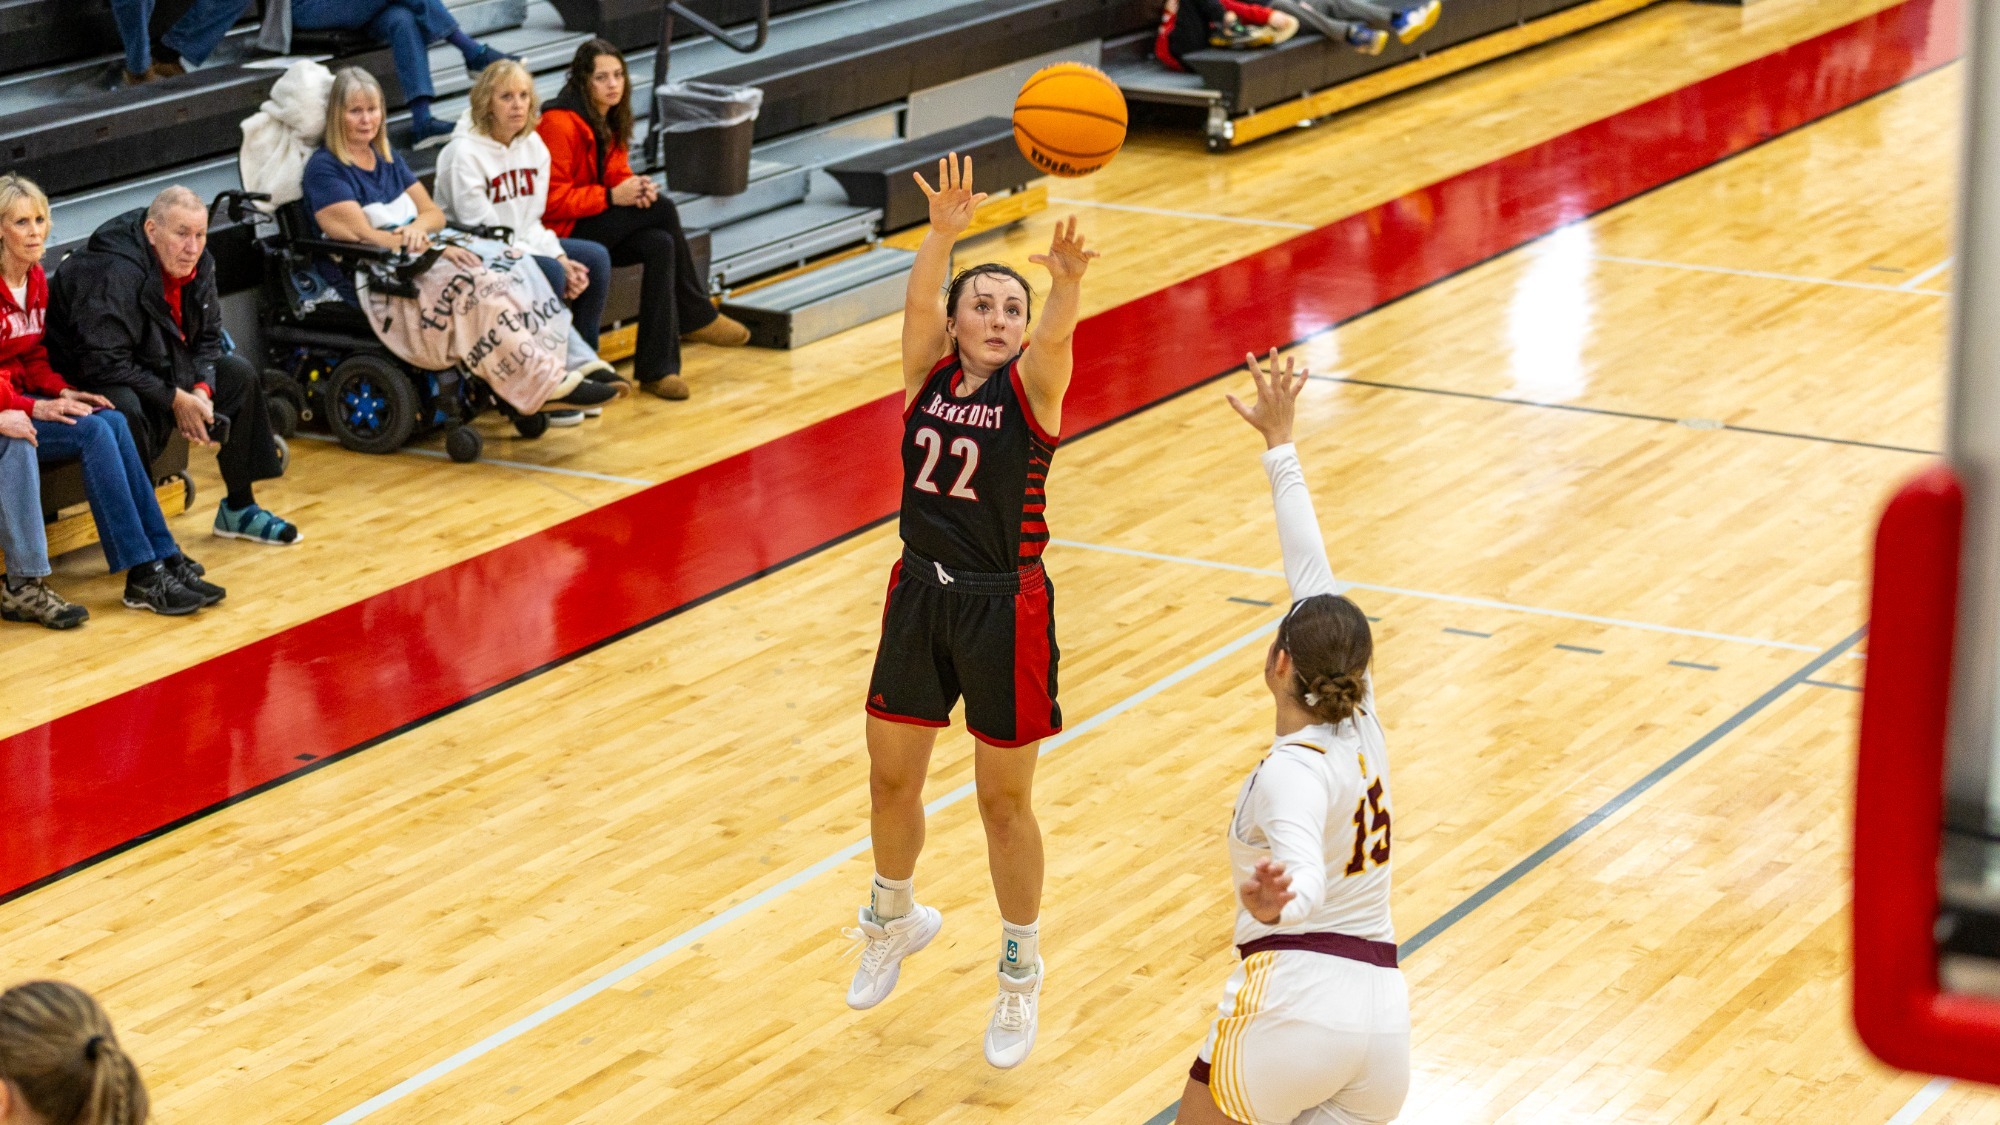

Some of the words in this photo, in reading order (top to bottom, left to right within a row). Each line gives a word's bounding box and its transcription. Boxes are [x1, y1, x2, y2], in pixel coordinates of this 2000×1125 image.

[421, 268, 476, 332] Every
[927, 393, 1004, 430] BENEDICT
[913, 425, 979, 502] 22
[1344, 775, 1391, 878] 15
